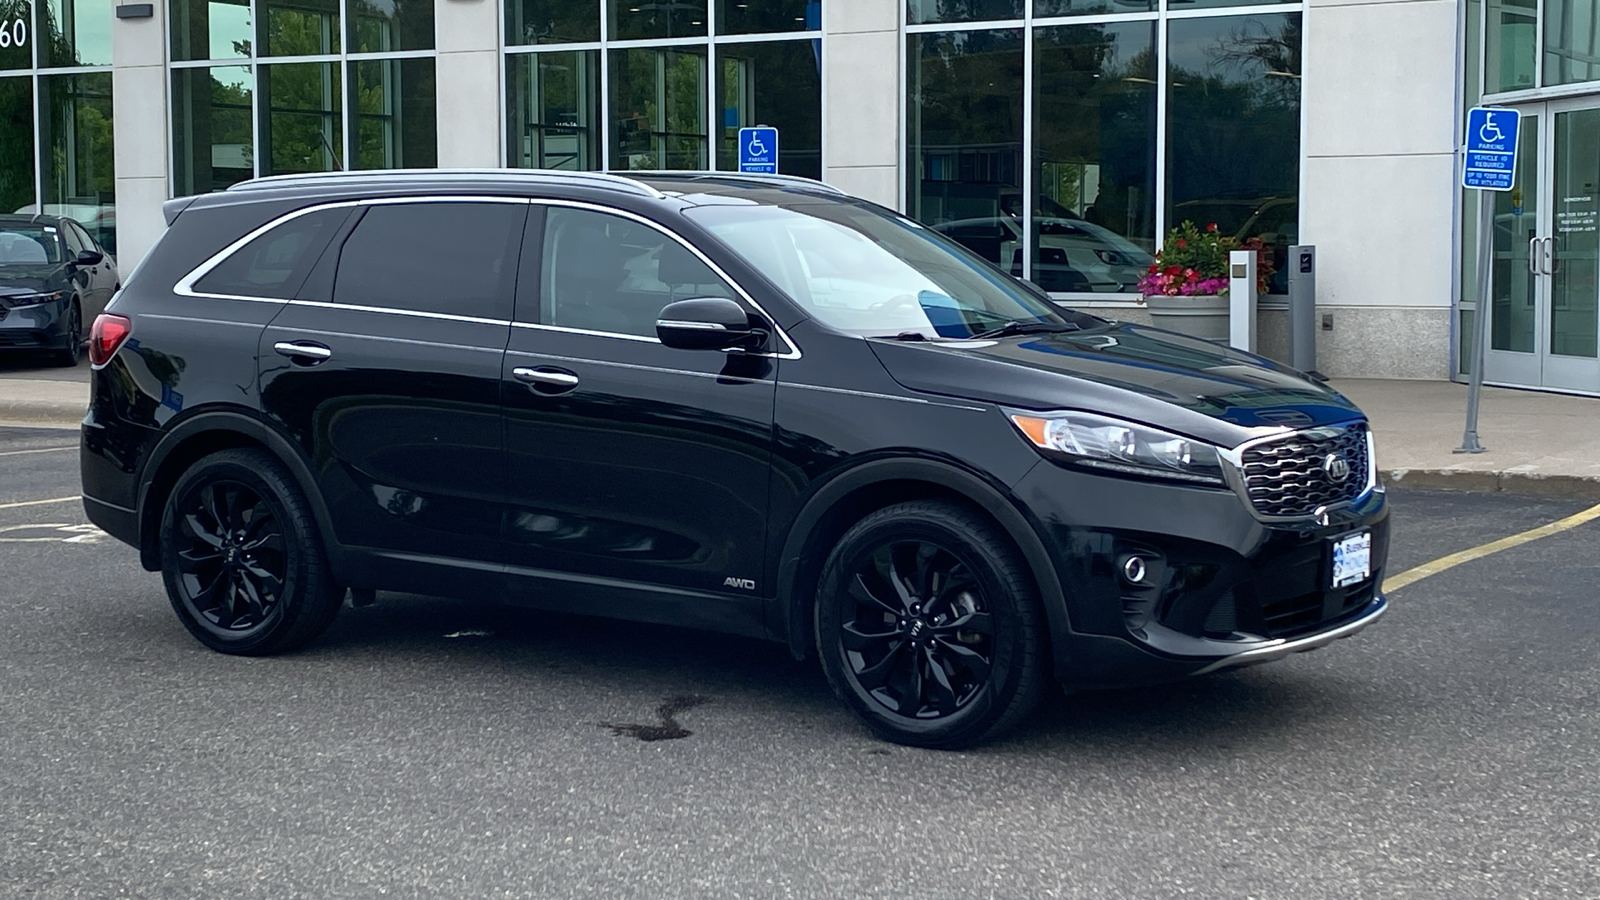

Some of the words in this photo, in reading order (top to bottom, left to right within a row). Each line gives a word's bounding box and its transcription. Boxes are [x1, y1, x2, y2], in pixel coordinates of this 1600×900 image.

[0, 18, 26, 47] 60
[1474, 154, 1499, 162] VEHICLE
[1475, 161, 1505, 169] REQUIRED
[1331, 459, 1349, 478] KIA
[723, 576, 756, 590] AWD
